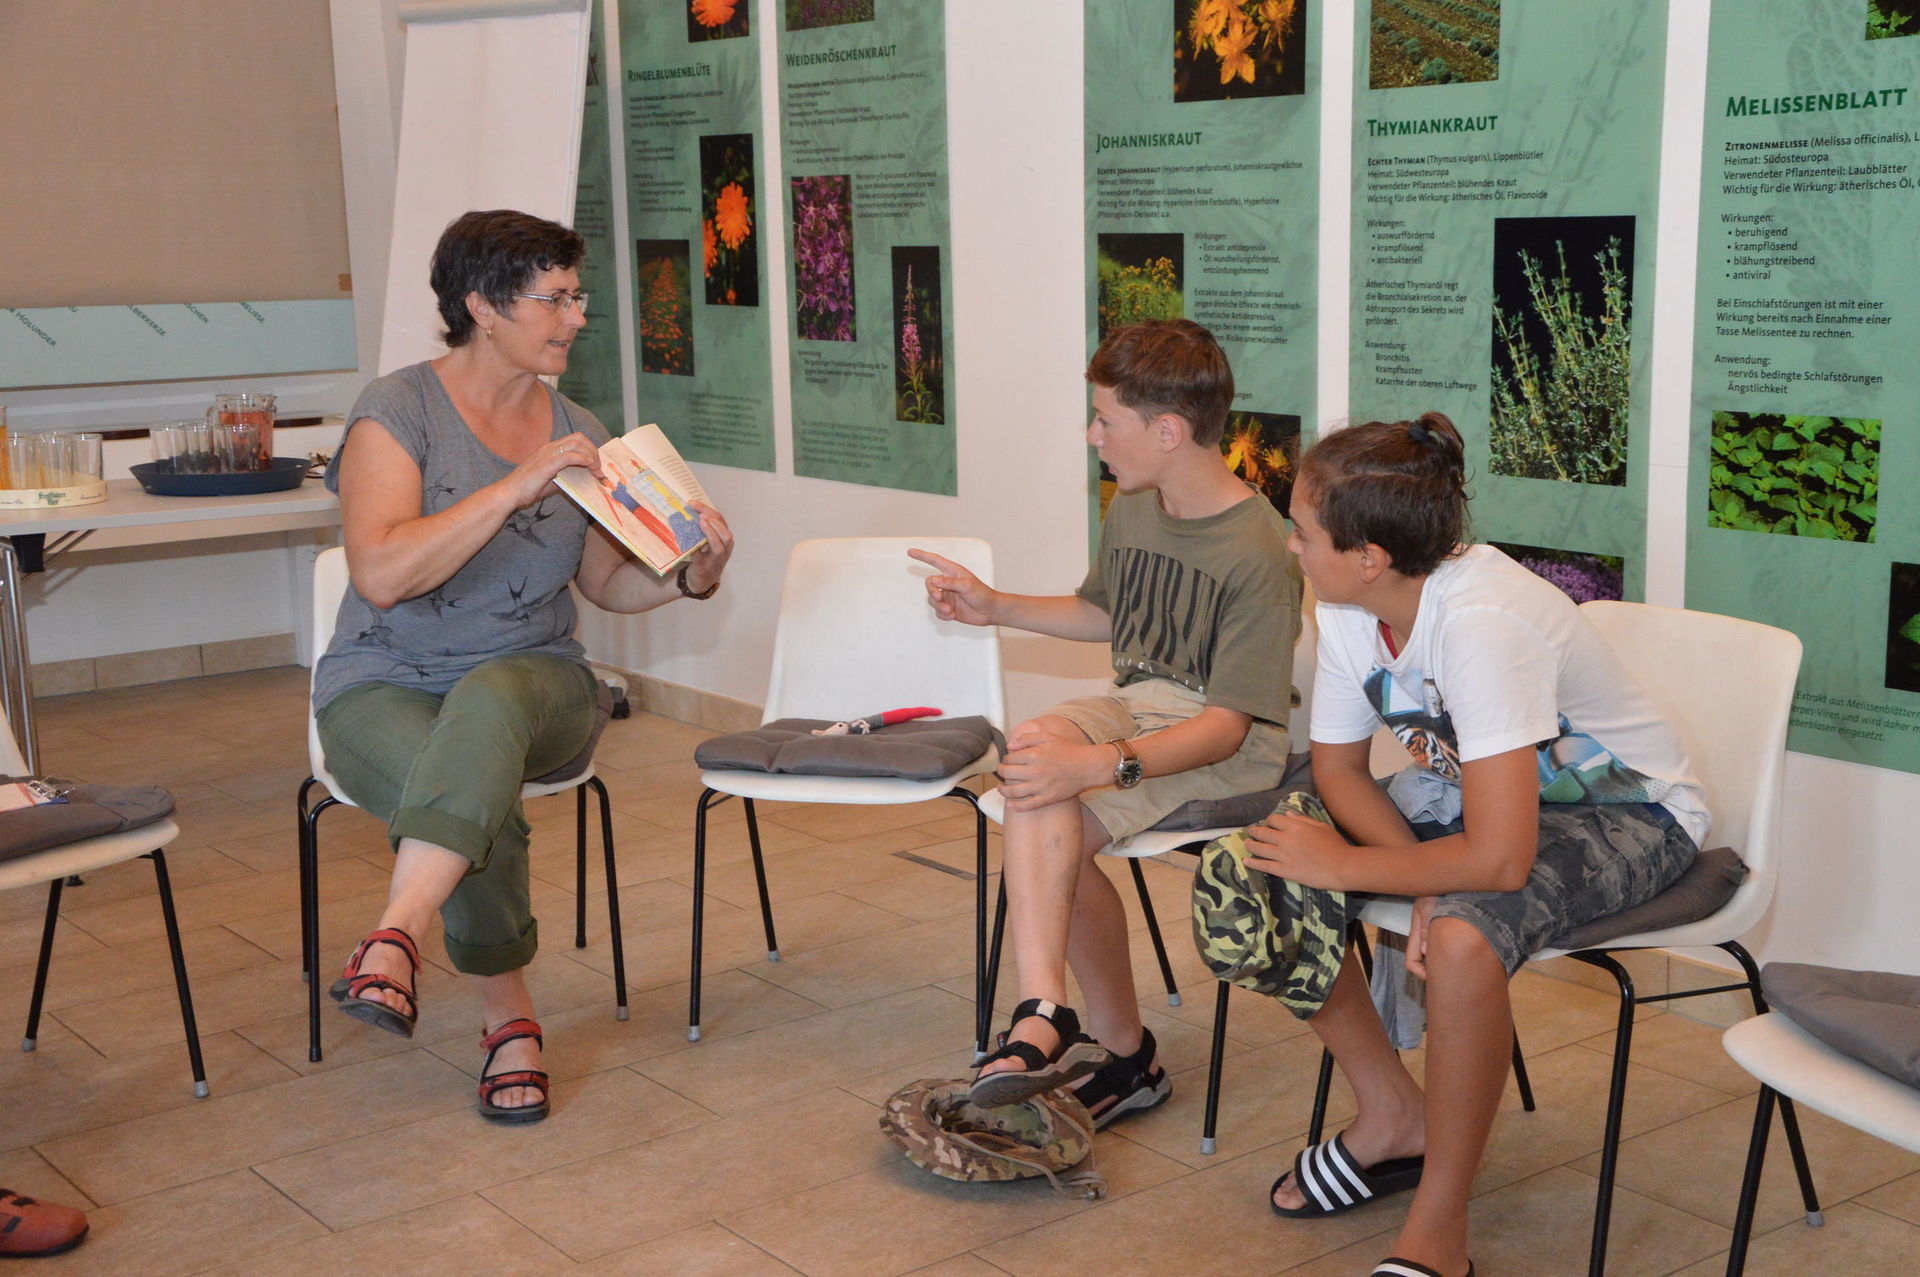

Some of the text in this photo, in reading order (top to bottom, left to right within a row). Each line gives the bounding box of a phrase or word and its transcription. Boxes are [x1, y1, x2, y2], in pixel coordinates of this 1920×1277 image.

[786, 45, 896, 67] WEIDENRÖSCHENKRAUT
[628, 62, 711, 82] RINGELBLUMENBLÜTE
[1726, 88, 1907, 117] MELISSENBLATT
[1367, 116, 1498, 137] THYMIANKRAUT
[1096, 132, 1202, 153] JOHANNISKRAUT
[1726, 139, 1809, 152] ZITRONENMELISSE
[1810, 136, 1852, 149] (Melissa
[1854, 131, 1911, 145] officinalis),
[1368, 156, 1393, 166] ECHTER
[1394, 156, 1426, 165] THYMIAN
[1427, 154, 1457, 166] (Thymus
[1494, 151, 1544, 164] Lippenblütler
[1724, 153, 1829, 166] Heimat: Südosteuropa
[1368, 168, 1449, 179] Heimat: Südwesteuropa
[1724, 164, 1907, 180] Verwendeter Pflanzenteil: Laubblätter
[1368, 182, 1411, 191] Verwendeter
[1458, 179, 1495, 188] blühendes
[1497, 178, 1517, 187] Kraut
[1723, 185, 1758, 196] Wichtig
[1760, 184, 1774, 194] für
[1775, 184, 1791, 193] die
[1793, 182, 1837, 194] Wirkung:
[1840, 180, 1897, 191] ätherisches
[1900, 177, 1915, 190] Öl,
[1367, 193, 1393, 205] Wichtig
[1394, 193, 1405, 203] für
[1406, 193, 1417, 202] die
[1418, 192, 1451, 204] Wirkung:
[1452, 192, 1493, 201] ätherisches
[1508, 190, 1548, 200] Flavonoide
[1367, 220, 1405, 230] Wirkungen:
[1722, 213, 1774, 225] Wirkungen:
[1377, 231, 1435, 240] auswurffördernd
[1735, 227, 1788, 239] beruhigend
[1377, 244, 1424, 253] krampflösend
[1734, 241, 1798, 253] krampflösend
[1377, 256, 1423, 265] antibakteriell
[1734, 255, 1816, 268] blähungstreibend
[1733, 270, 1771, 280] antiviral
[1366, 278, 1459, 292] Ätherisches Thymianöl regt
[1366, 293, 1376, 301] die
[1377, 292, 1442, 302] Bronchialsekretion
[1456, 294, 1467, 302] der
[1366, 305, 1464, 315] Abtransport des Sekrets wird
[1717, 298, 1884, 312] Bei Einschlafstörungen ist mit einer
[1716, 313, 1892, 325] Wirkung bereits nach Einnahme einer
[16, 311, 57, 346] HOLUNDER
[1716, 326, 1855, 339] Tasse Melissentee zu rechnen.
[1365, 341, 1407, 352] Anwendung:
[1376, 353, 1410, 362] Bronchitis
[1714, 354, 1771, 367] Anwendung:
[1376, 365, 1423, 375] Krampfhusten
[1728, 369, 1883, 386] nervös bedingte Schlafstörungen
[1376, 378, 1478, 392] Katarrhe der oberen Luftwege
[1728, 380, 1788, 395] Ängstlichkeit
